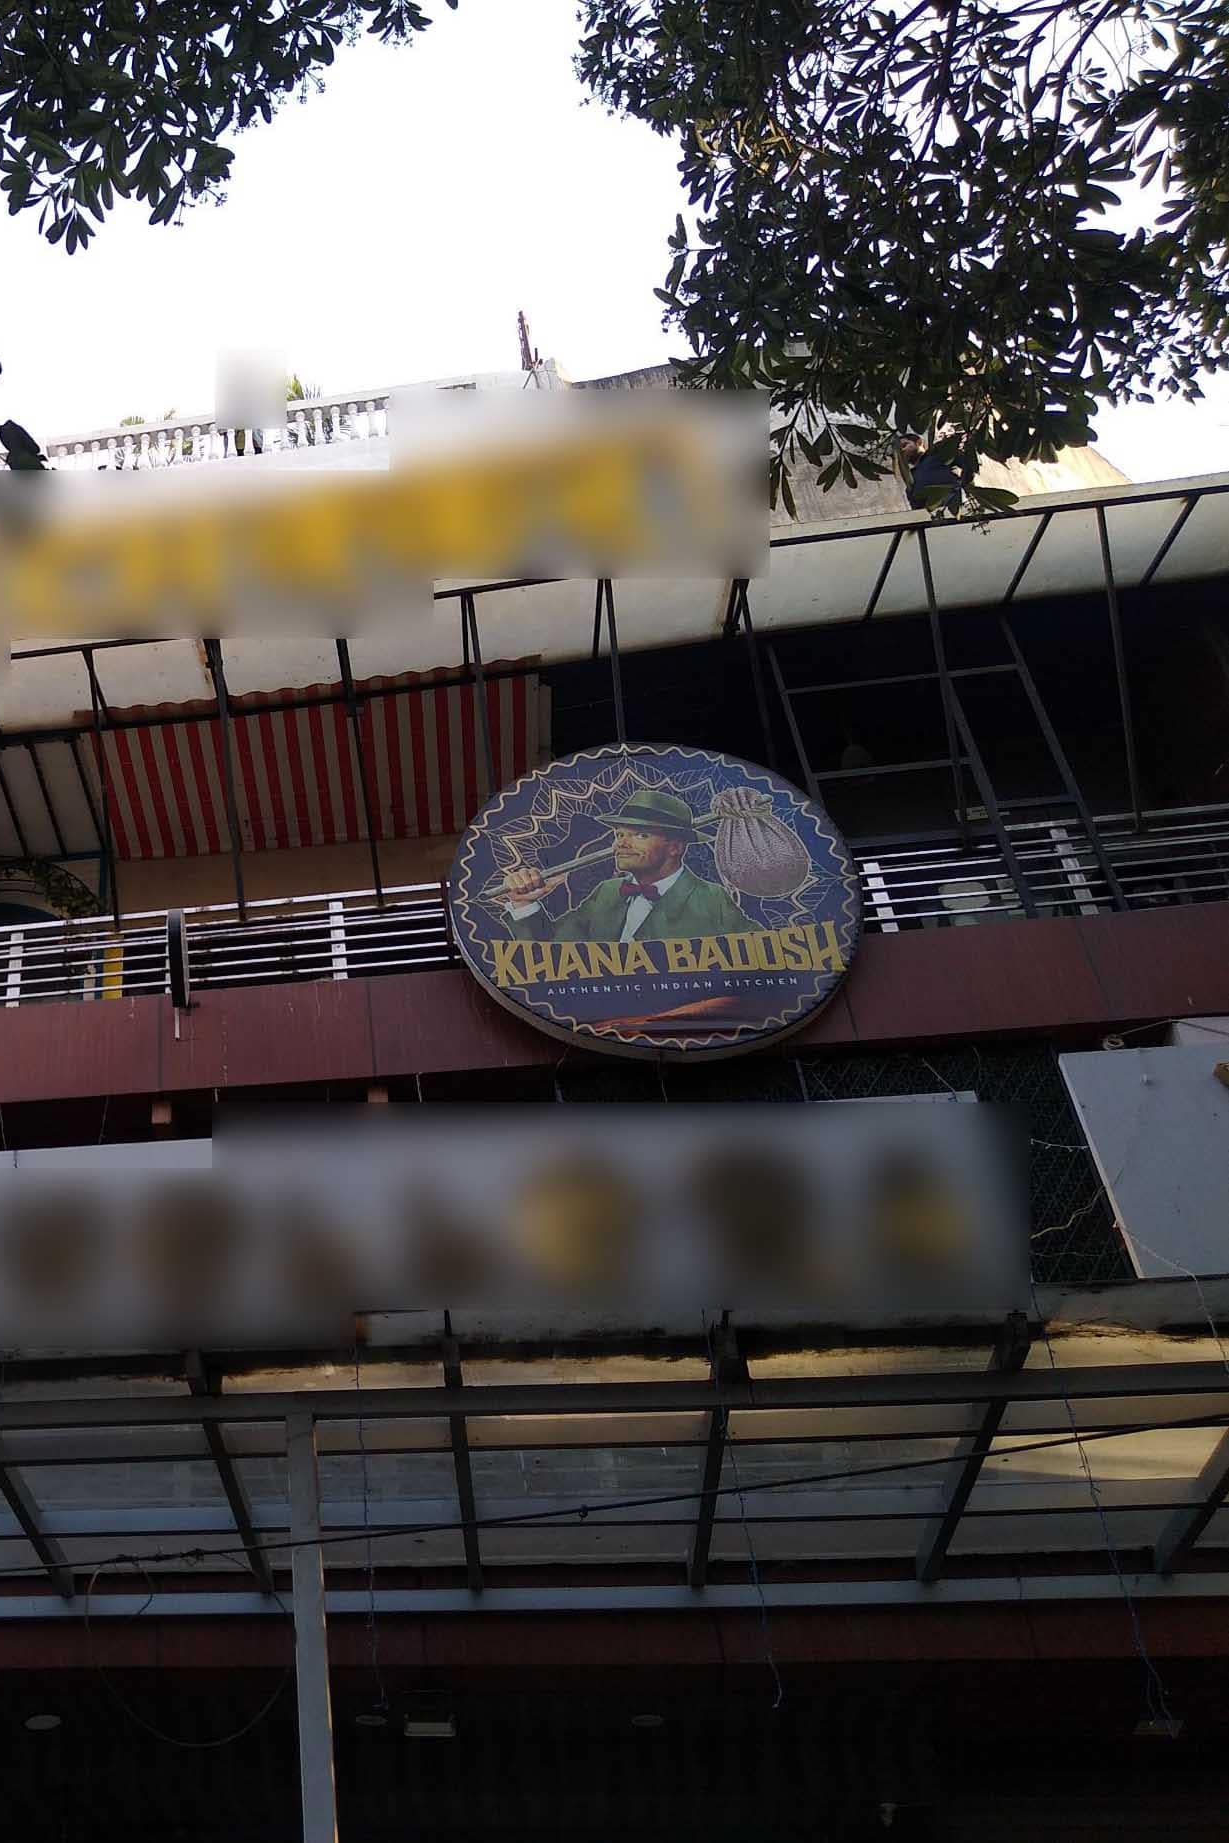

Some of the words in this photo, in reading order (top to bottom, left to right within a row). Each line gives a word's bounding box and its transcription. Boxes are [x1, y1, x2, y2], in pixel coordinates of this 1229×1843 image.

[490, 939, 660, 987] KHANA
[664, 920, 847, 972] BADOSH
[547, 983, 643, 996] AUTHENTIC
[652, 980, 713, 992] INDIAN
[723, 976, 798, 988] KITCHEN
